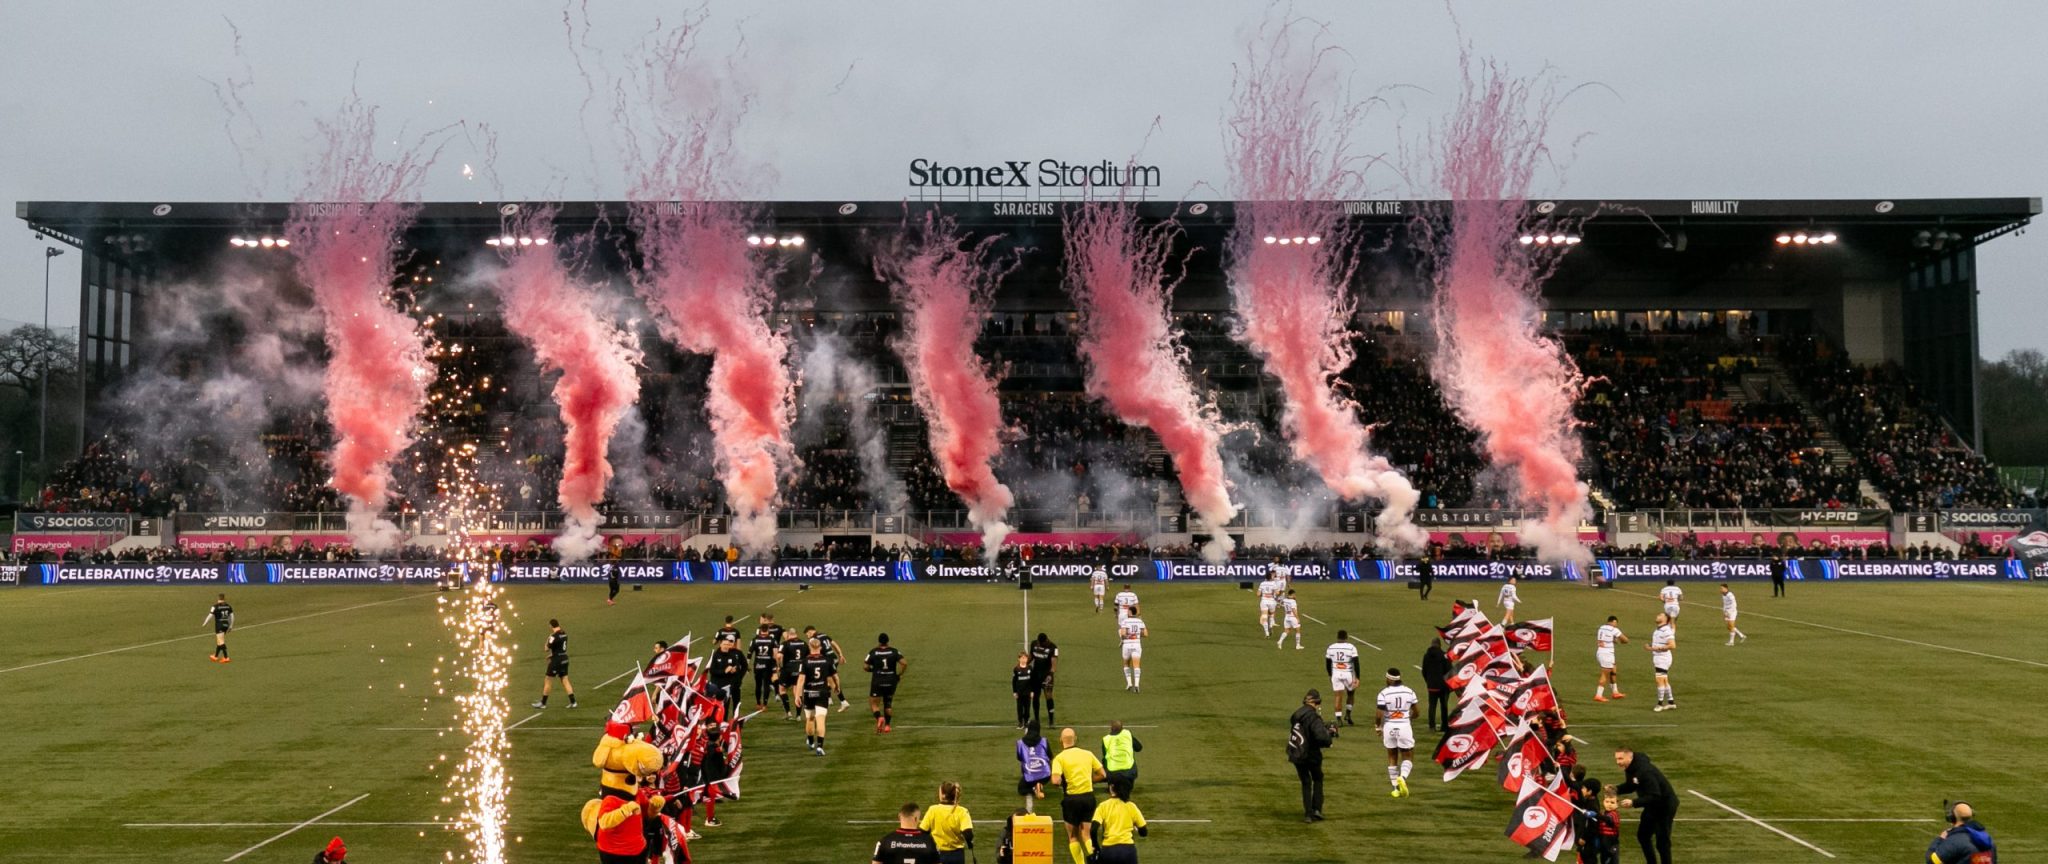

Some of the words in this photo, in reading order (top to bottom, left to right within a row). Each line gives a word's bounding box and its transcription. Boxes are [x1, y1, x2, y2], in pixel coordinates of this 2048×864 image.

[909, 158, 1031, 187] StoneX
[1039, 159, 1160, 187] Stadium
[994, 202, 1054, 216] SARACENS
[1343, 202, 1373, 214] WORK
[1376, 202, 1401, 214] RATE
[1691, 201, 1739, 214] HUMILITY
[47, 516, 126, 527] SOCIOS.com
[1420, 513, 1491, 522] CASTORE
[1800, 511, 1858, 521] HY-PRO
[1951, 512, 2032, 523] SOCIOS.com
[190, 540, 235, 549] shawbrk
[60, 568, 154, 579] CELEBRATING
[155, 565, 173, 579] 30
[174, 568, 218, 579] YEARS
[285, 568, 377, 578] CELEBRATING
[379, 564, 395, 578] 30
[397, 568, 441, 578] YEARS
[510, 566, 599, 577] ELEBATING
[619, 566, 664, 577] YEARS
[823, 562, 839, 576] 30
[841, 566, 886, 577] YEARS
[1031, 565, 1110, 576] CHAMPIOS
[1111, 565, 1139, 576] CUP
[1173, 565, 1265, 576] CELEBRATING
[1285, 565, 1329, 576] YEAR
[1395, 565, 1488, 576] CELBRATING
[1489, 562, 1505, 575] 30
[1506, 565, 1552, 576] YARS
[1617, 565, 1710, 576] CELEBRATING
[1711, 562, 1727, 575] 30
[1729, 565, 1772, 576] YEARS
[1840, 565, 1932, 576] CELEBRATING
[1933, 561, 1949, 574] 30
[1951, 565, 1997, 576] YEARS
[1131, 624, 1139, 633] 10
[758, 646, 769, 656] 12
[795, 649, 801, 660] 3
[1336, 651, 1345, 661] 12
[882, 658, 889, 669] 1
[814, 667, 821, 679] 5
[1395, 697, 1402, 709] 11
